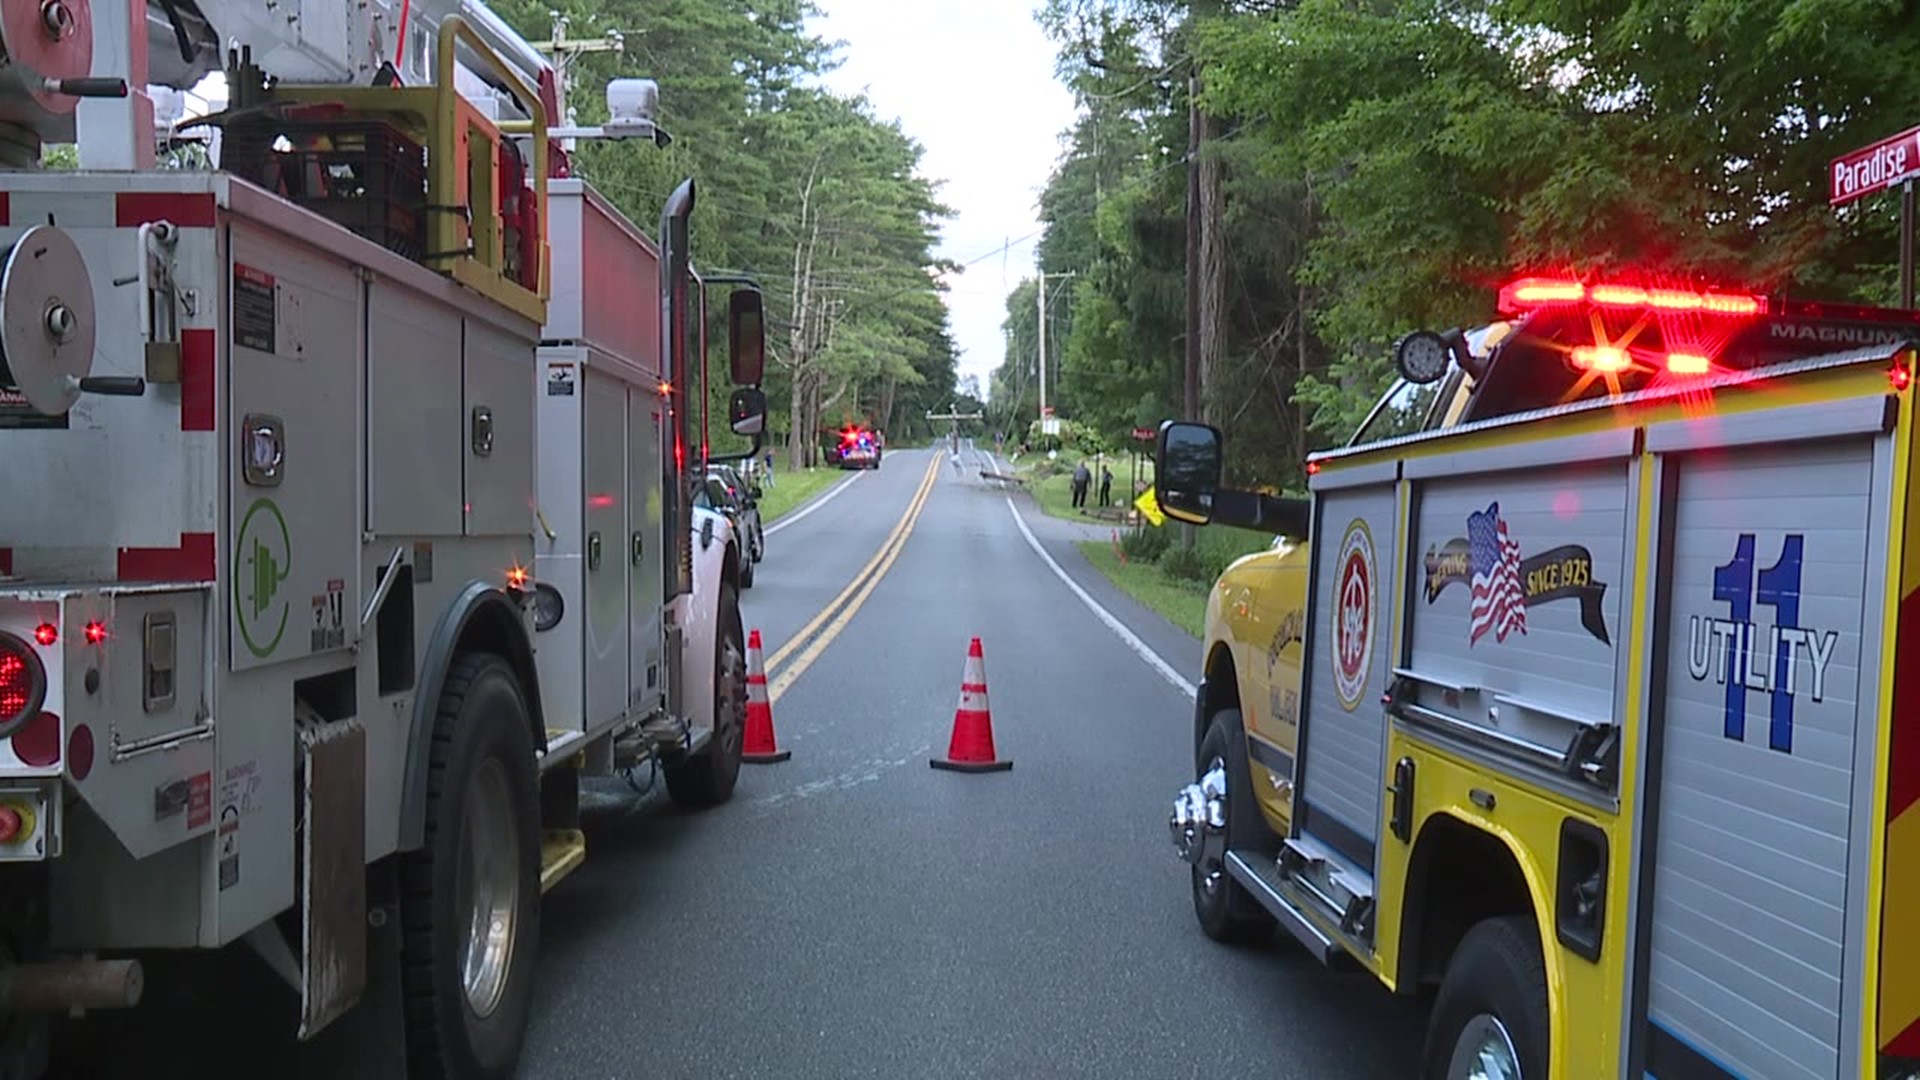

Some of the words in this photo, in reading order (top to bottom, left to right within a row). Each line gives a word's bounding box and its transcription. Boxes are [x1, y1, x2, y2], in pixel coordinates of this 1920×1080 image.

[1835, 145, 1906, 197] Paradise
[1770, 323, 1900, 344] MAGNUM
[1526, 563, 1559, 597] SINCE
[1560, 559, 1588, 587] 1925
[1689, 615, 1838, 703] UTILITY
[1713, 533, 1803, 754] 11
